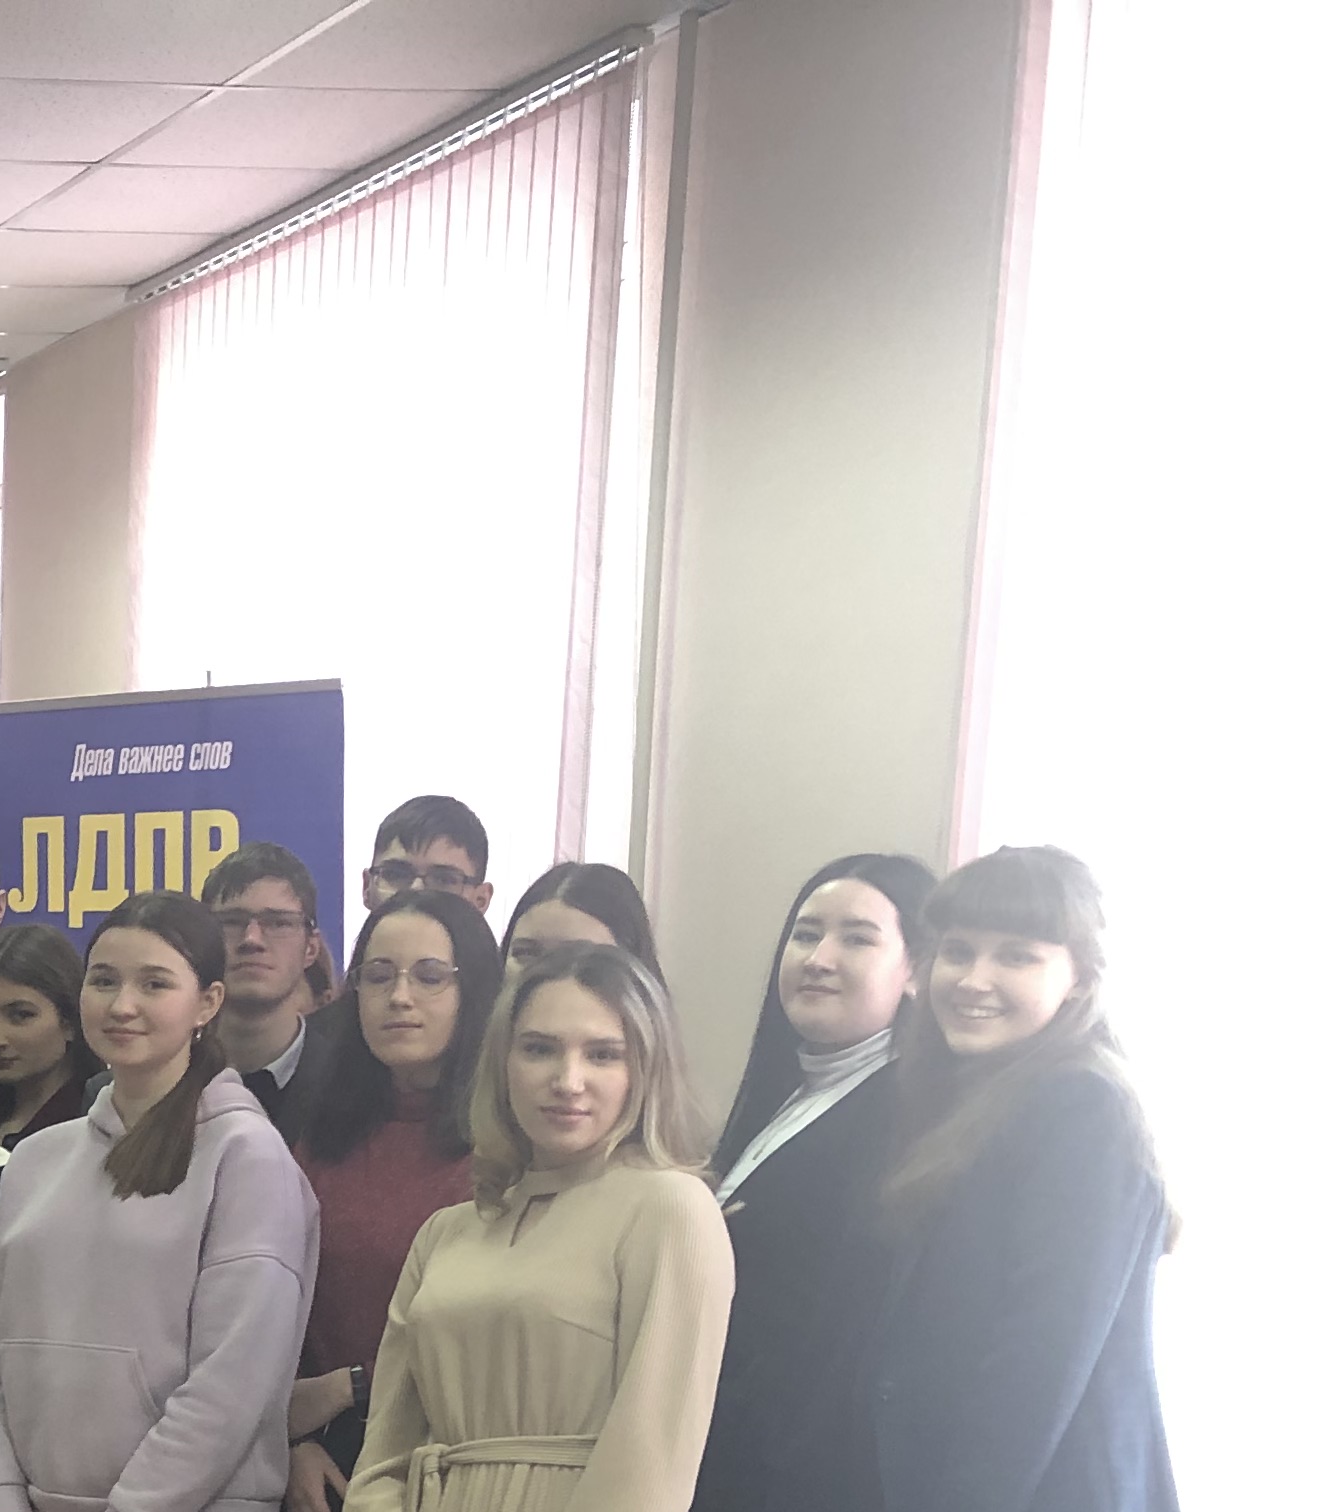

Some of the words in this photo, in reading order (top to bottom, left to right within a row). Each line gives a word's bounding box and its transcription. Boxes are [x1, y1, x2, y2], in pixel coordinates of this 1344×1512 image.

[71, 742, 112, 782] Дела
[118, 744, 183, 776] важнее
[189, 740, 233, 771] слов
[8, 809, 241, 929] ЛДПР
